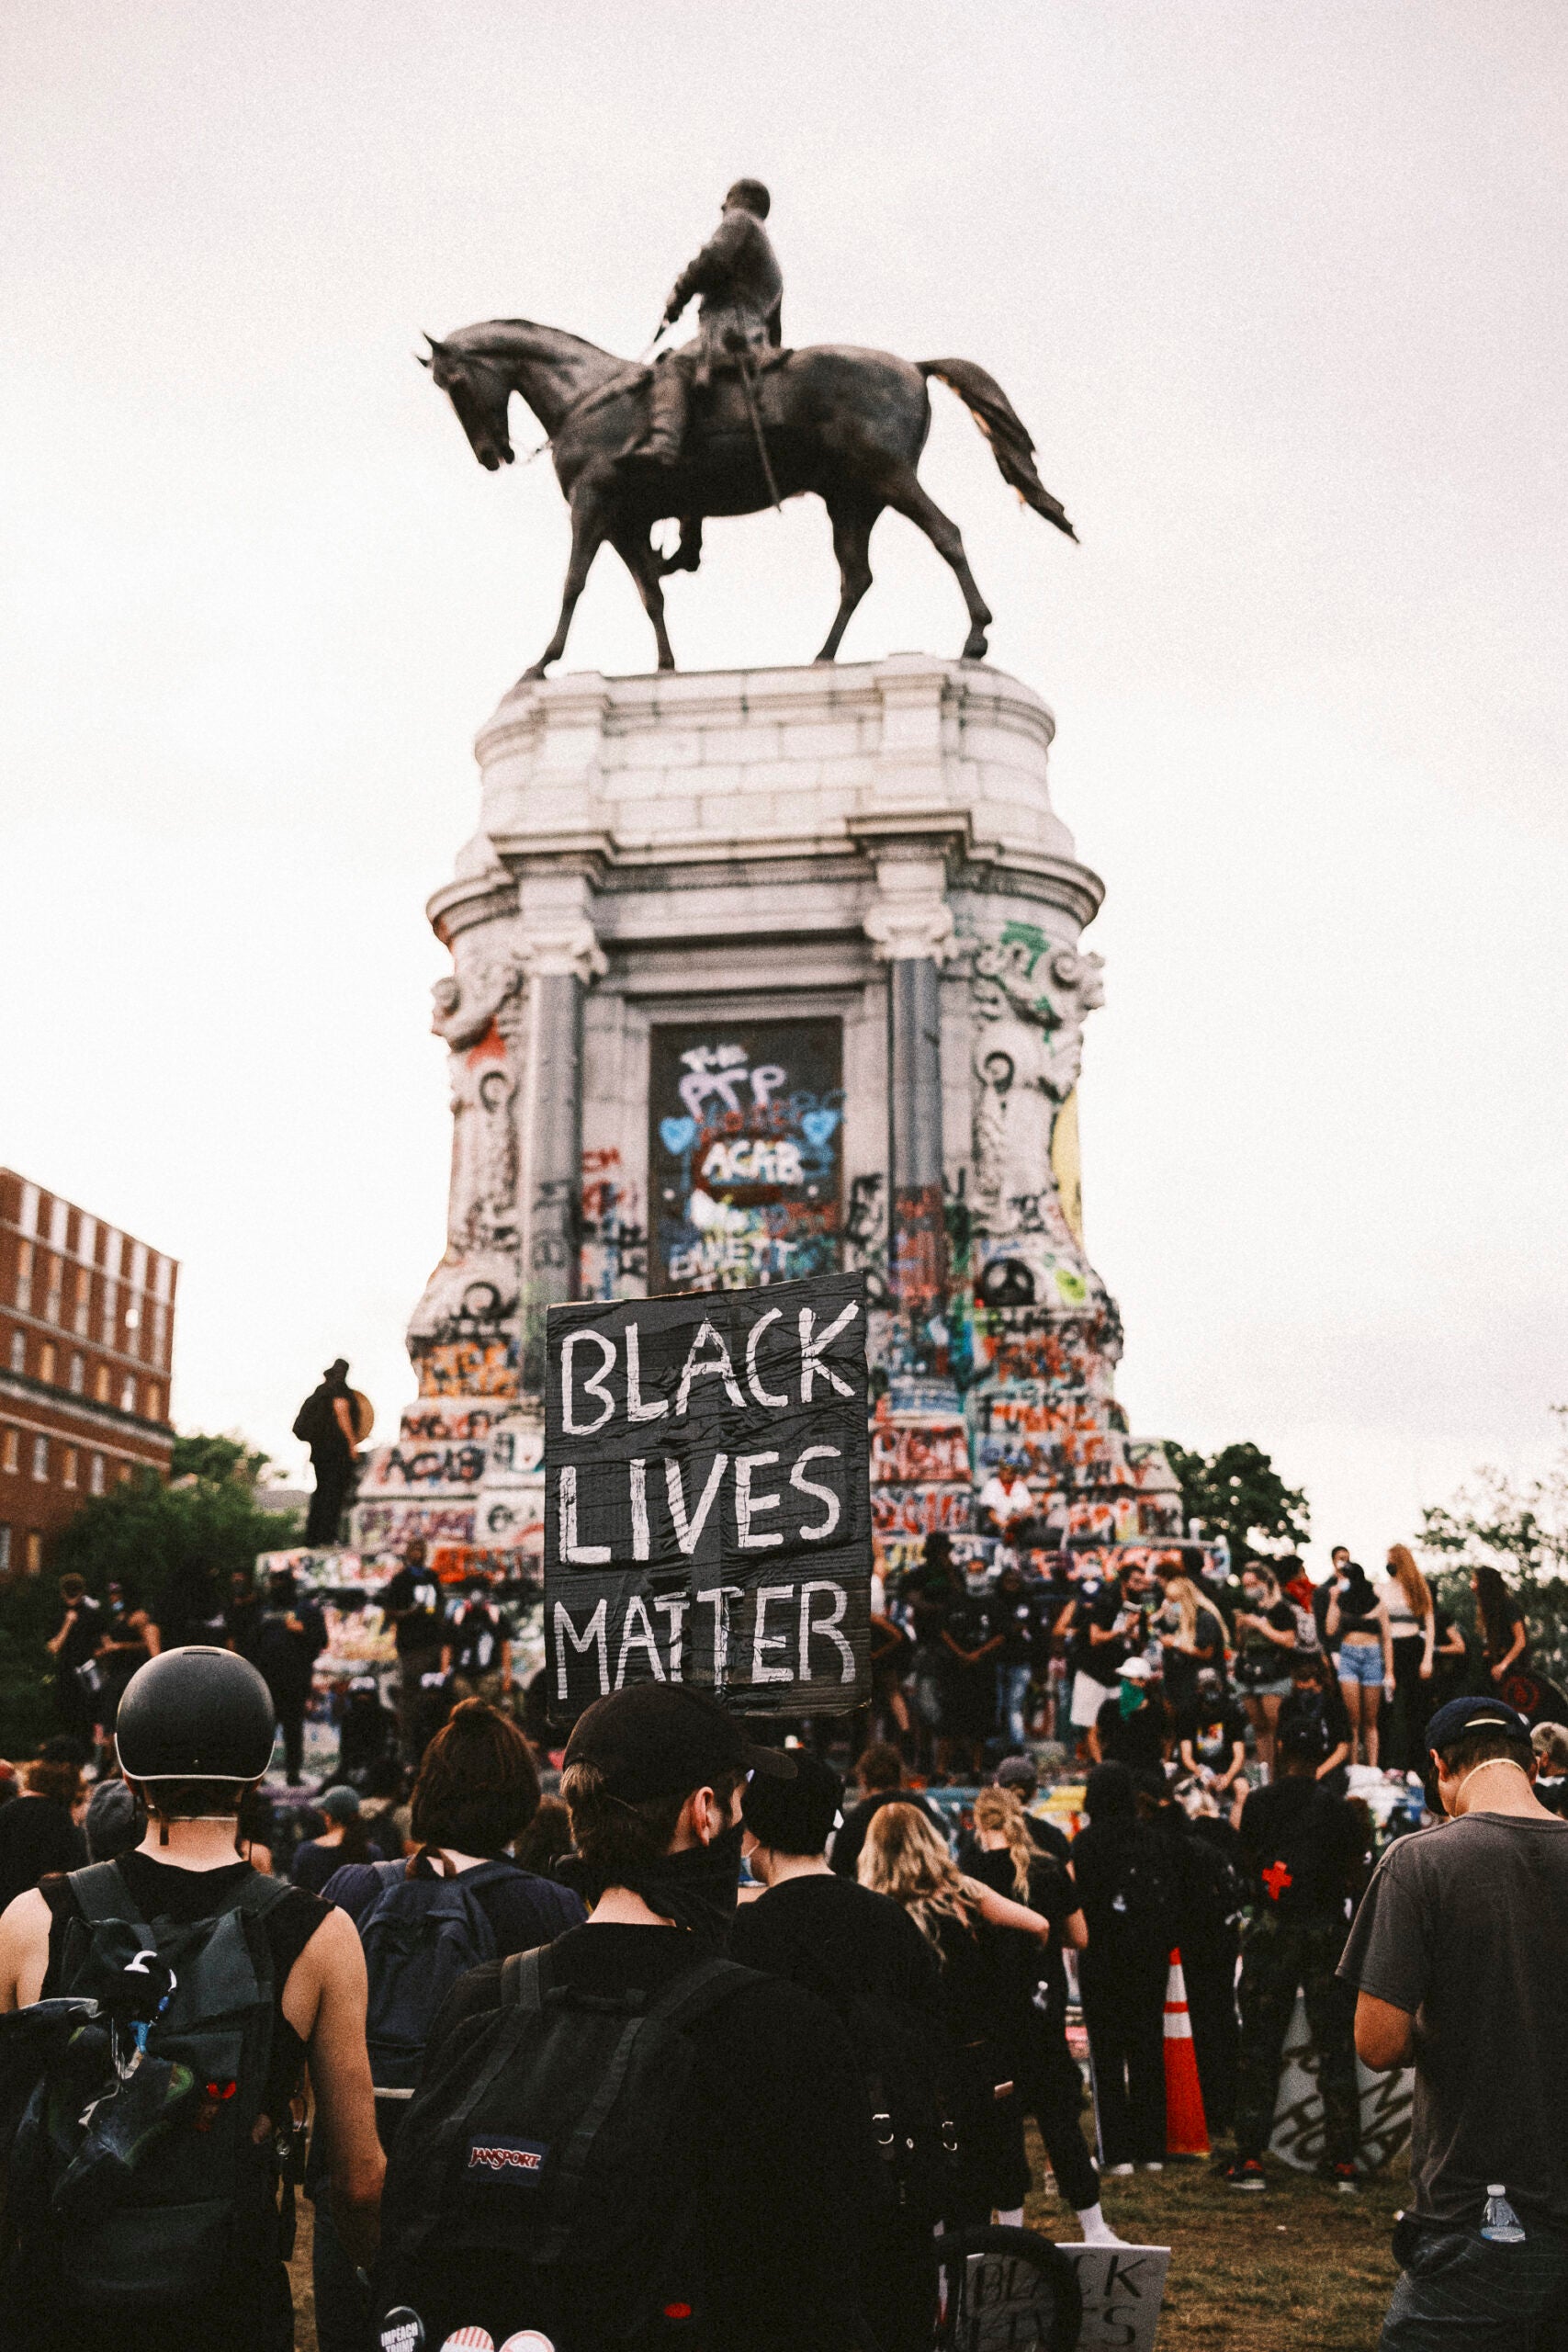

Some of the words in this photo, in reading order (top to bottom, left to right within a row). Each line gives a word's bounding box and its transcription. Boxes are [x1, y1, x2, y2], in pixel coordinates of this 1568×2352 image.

[700, 1139, 805, 1185] ACAB
[560, 1299, 859, 1436] BLACK
[558, 1445, 842, 1565] LIVES
[553, 1580, 856, 1701] MATTER
[468, 2146, 542, 2170] JANSPORT
[974, 2253, 1147, 2307] BLCK
[380, 2322, 419, 2347] IMPEACH
